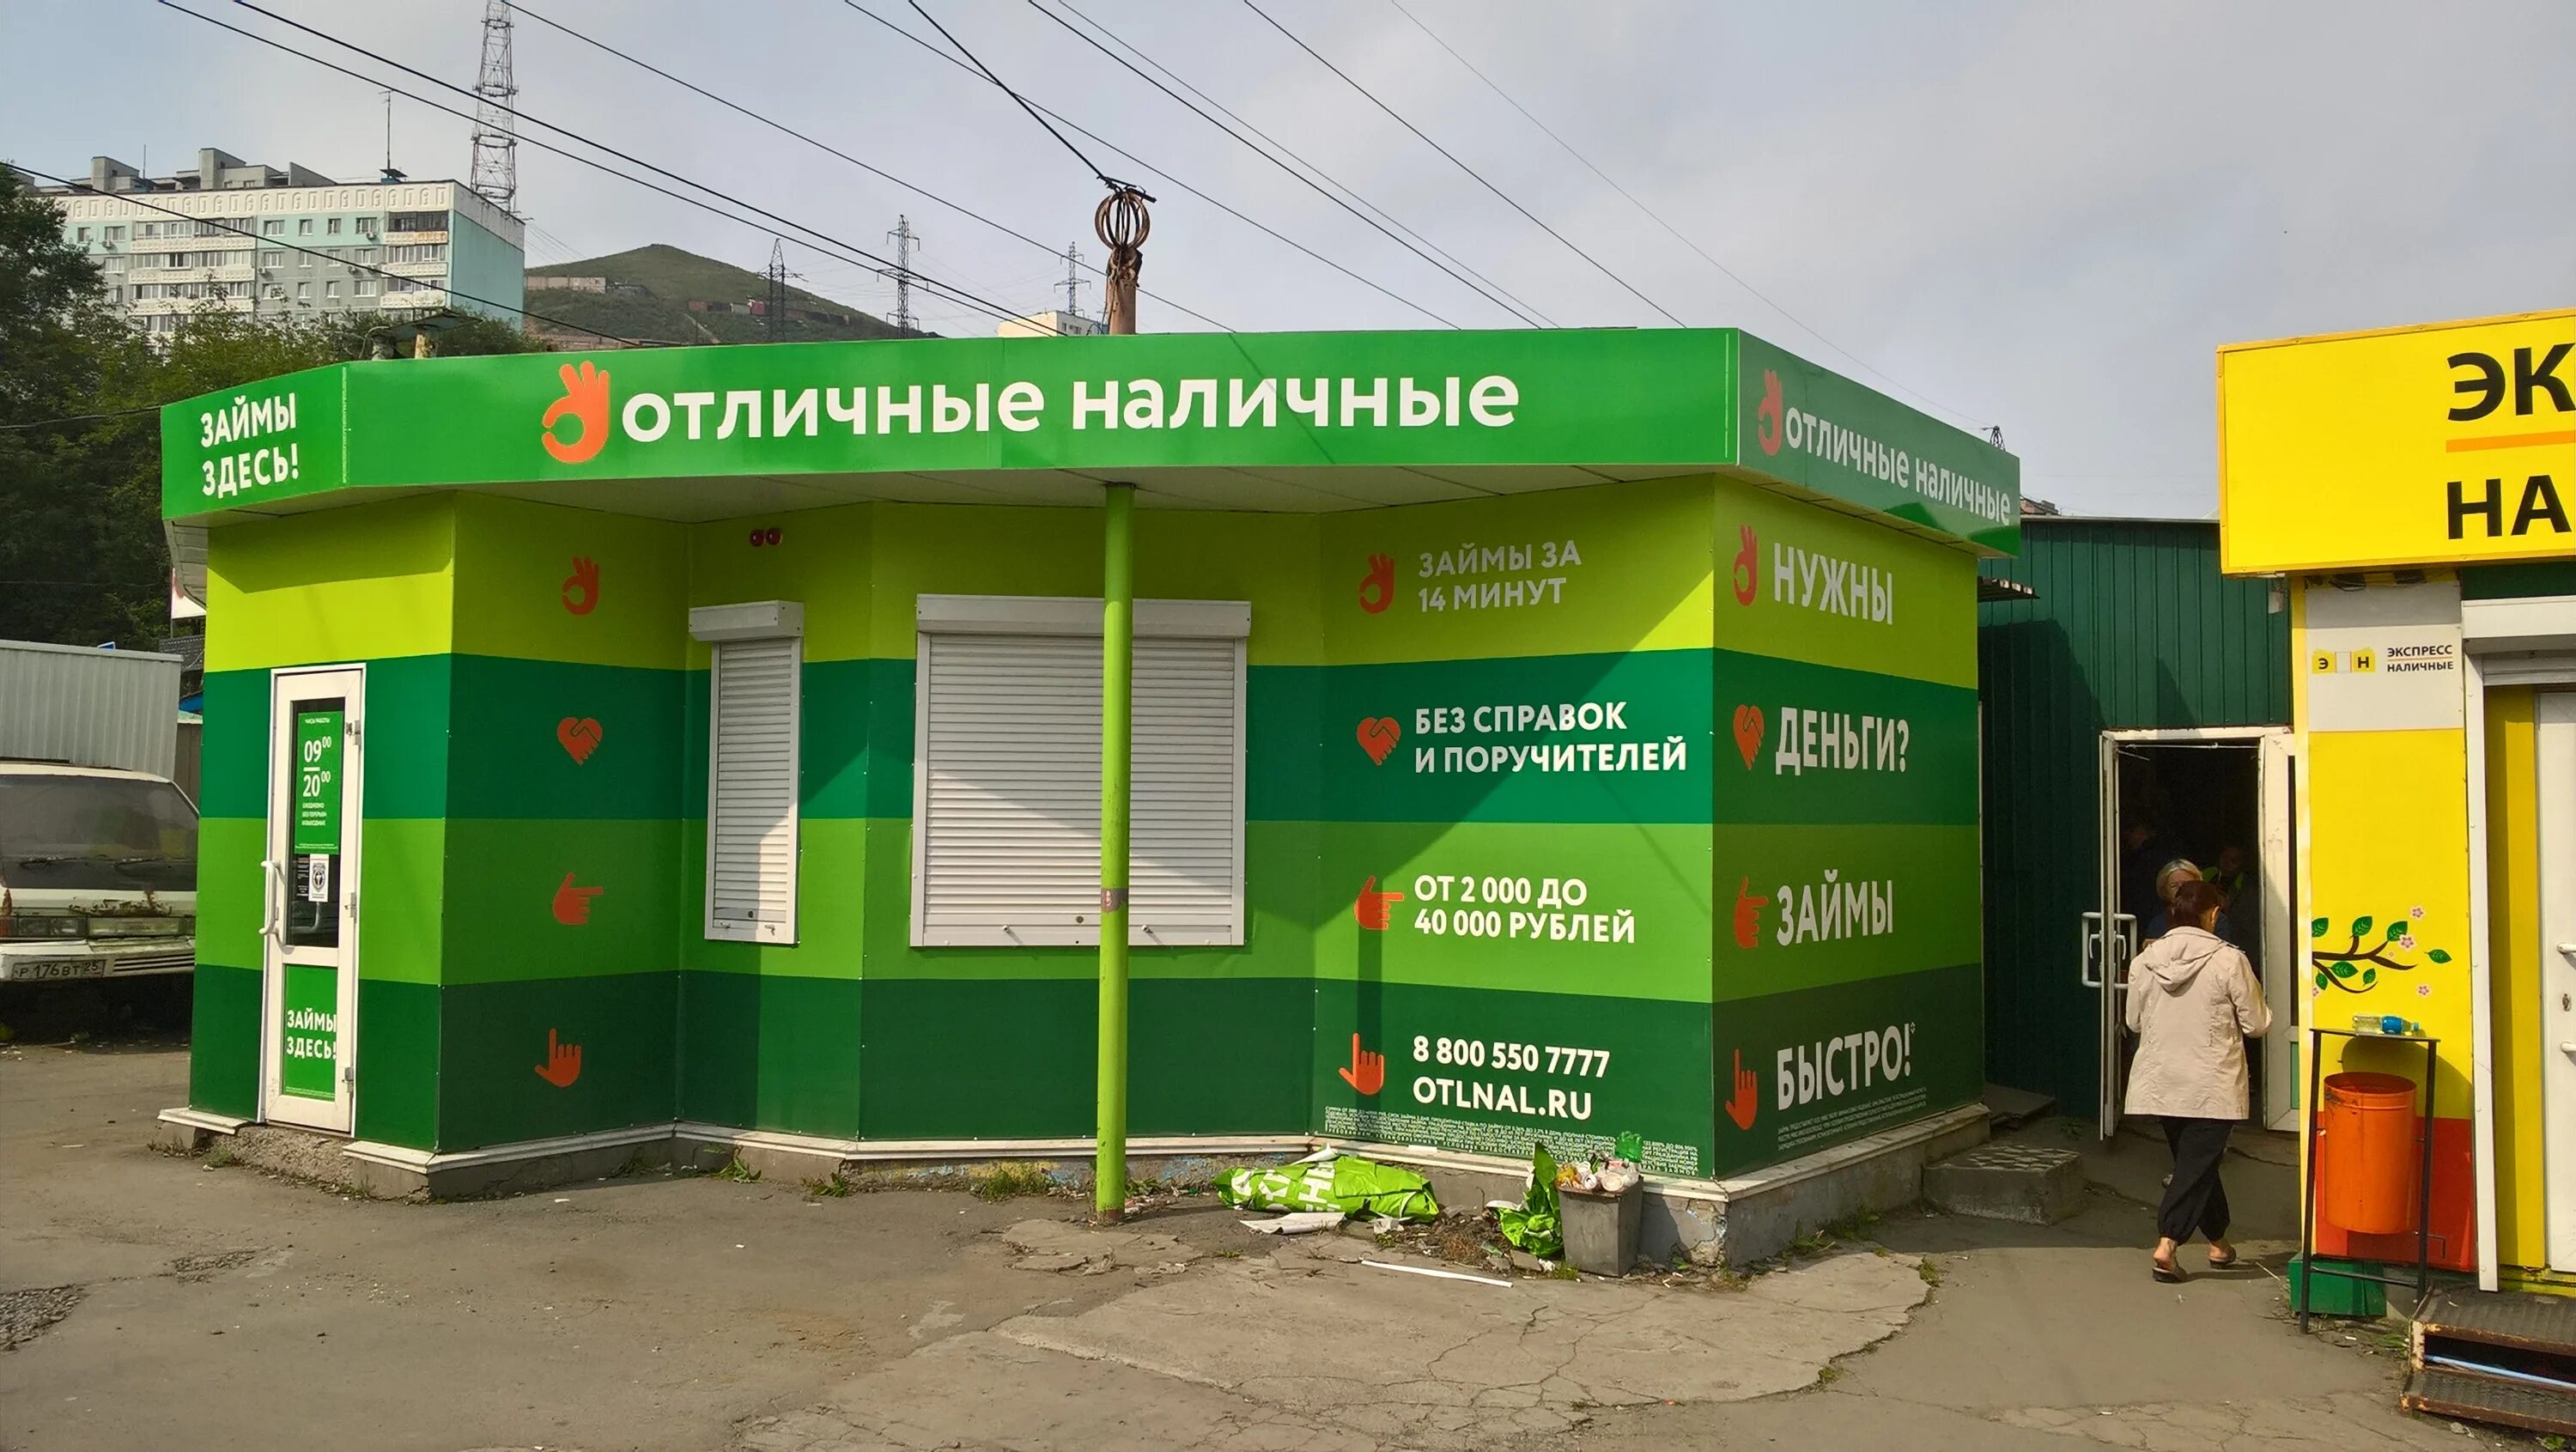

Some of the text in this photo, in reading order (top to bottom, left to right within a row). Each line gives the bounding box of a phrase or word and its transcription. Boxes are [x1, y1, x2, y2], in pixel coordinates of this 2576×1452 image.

[2446, 343, 2576, 422] ЭК
[200, 392, 296, 448] ЗАЙМЫ
[622, 374, 1519, 442] отличные наличные
[202, 443, 300, 498] ЗДЕСЬ!
[1785, 407, 2011, 526] отличные наличные
[2446, 474, 2573, 540] НА
[1418, 540, 1582, 578] ЗАЙМЫ ЗА
[1418, 577, 1567, 612] 14 МИНУТ
[1773, 543, 1893, 625] НУЖНЫ
[2318, 656, 2369, 670] Э Н
[2387, 645, 2453, 658] ЭКСПРЕСС
[2387, 661, 2454, 672] НАЛИЧНЫЕ
[1415, 702, 1628, 734] БЕЗ СПРАВОК
[304, 739, 322, 762] 09
[1415, 736, 1686, 773] И ПОРУЧИТЕЛЕЙ
[1775, 706, 1910, 776] ДЕНЬГИ?
[302, 775, 321, 797] 20
[1414, 875, 1588, 909] ОТ 2 000 ДО
[1777, 869, 1893, 946] ЗАЙМЫ
[1414, 908, 1635, 944] 40 000 РУБЛЕЙ
[287, 1007, 337, 1032] ЗАЙМЫ
[286, 1036, 337, 1060] ЗДЕСЬ!
[1413, 1036, 1610, 1078] 8 800 550 7777
[1413, 1076, 1592, 1120] OTLNAL.RU
